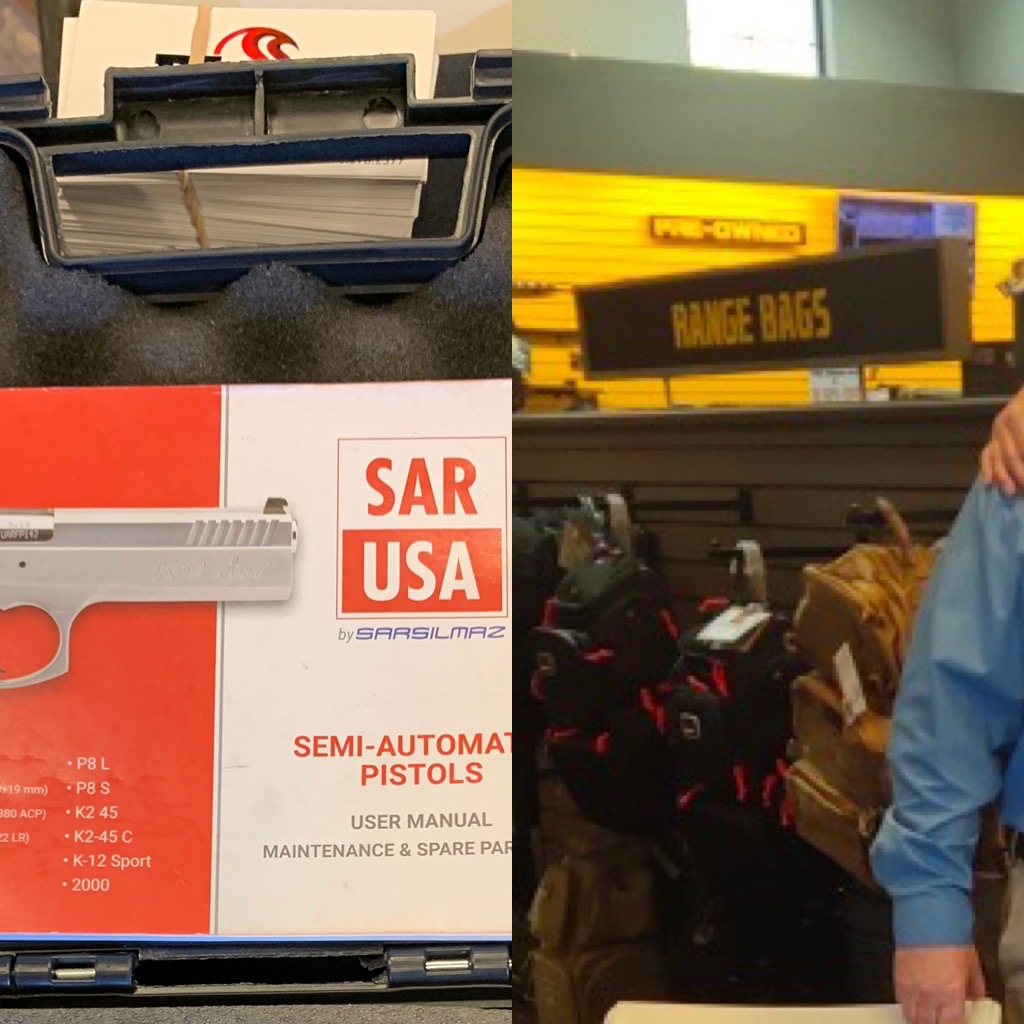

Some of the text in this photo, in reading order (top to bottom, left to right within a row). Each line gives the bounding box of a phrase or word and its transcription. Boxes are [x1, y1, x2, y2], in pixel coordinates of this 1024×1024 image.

[670, 288, 831, 348] RANGE BAGS
[366, 457, 478, 516] SAR
[363, 541, 480, 602] USA
[338, 626, 506, 643] by SARSILMAZ
[77, 757, 110, 770] P8 L
[361, 762, 483, 786] PISTOLS
[0, 784, 49, 797] x19 mm)
[76, 782, 110, 795] P8 S
[19, 808, 47, 820] ACP)
[75, 806, 118, 819] K2 45
[351, 812, 493, 830] USER MANUAL
[11, 832, 30, 845] LR)
[74, 830, 133, 843] K2-45 C
[263, 843, 395, 859] MAINTENANCE
[400, 843, 411, 857] &
[417, 841, 475, 856] SPARE
[73, 854, 151, 870] K-12 Sport
[72, 878, 110, 892] 2000
